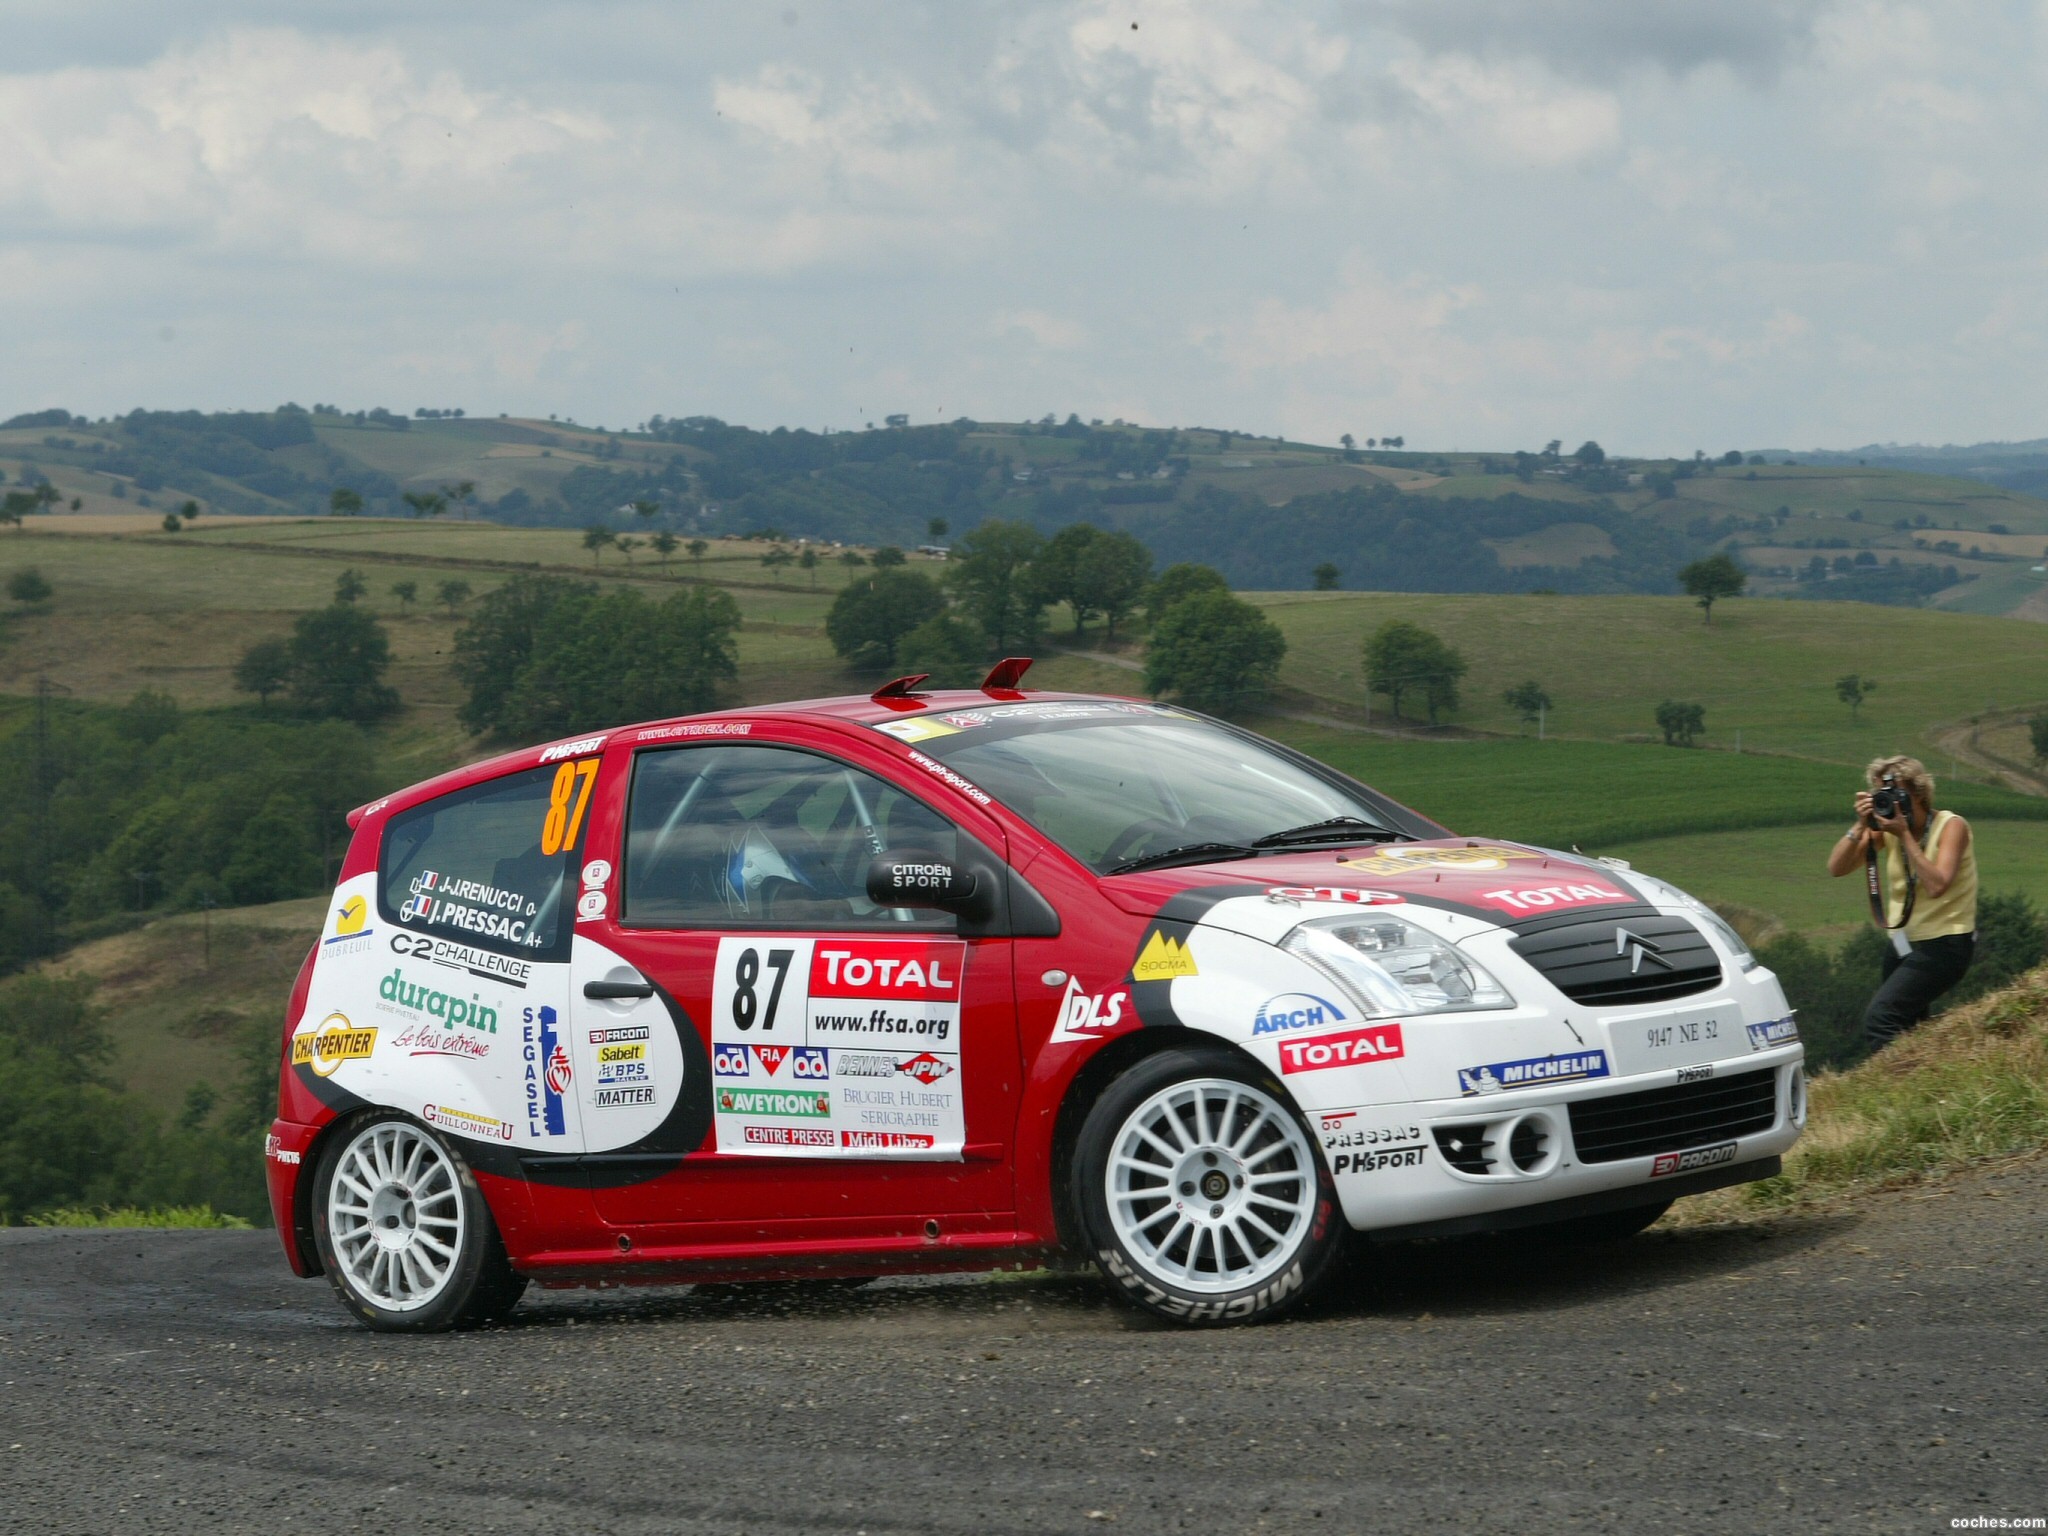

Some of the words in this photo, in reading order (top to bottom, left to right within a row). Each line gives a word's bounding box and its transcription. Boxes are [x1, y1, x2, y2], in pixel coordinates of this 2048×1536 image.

[541, 758, 600, 856] 87
[892, 863, 952, 877] CITROËN
[893, 875, 952, 888] SPORT
[1482, 884, 1625, 909] TOTAL
[428, 900, 526, 943] J.PRESSAC
[525, 931, 543, 948] A+
[321, 940, 373, 960] DUBREUIL
[390, 933, 432, 961] C2
[433, 942, 532, 980] CHALLENGE
[820, 951, 953, 988] TOTAL
[1140, 959, 1187, 972] SOCMA
[380, 968, 498, 1034] durapin
[732, 947, 796, 1031] 87
[1066, 992, 1126, 1030] DLS
[1252, 1006, 1325, 1036] ARCH
[606, 1028, 648, 1041] FACOM
[815, 1010, 950, 1039] www.ffsa.org
[1647, 1026, 1673, 1048] 9147
[1680, 1023, 1699, 1044] NE
[295, 1033, 371, 1059] CHARPENTIER
[601, 1046, 641, 1061] Sabelt
[760, 1048, 781, 1062] FIA
[1283, 1035, 1399, 1066] TOTAL
[523, 1007, 541, 1137] SEGASEL
[616, 1063, 646, 1076] BPS
[836, 1055, 899, 1077] BENNES
[904, 1061, 949, 1077] JPM
[1503, 1055, 1602, 1083] MICHELIN
[599, 1088, 653, 1105] MATTER
[734, 1092, 815, 1115] AVEYRON
[844, 1088, 895, 1106] BRUGIER
[900, 1090, 952, 1109] HUBERT
[422, 1104, 514, 1140] GUILLONNEAU
[861, 1110, 939, 1127] SERIGRAPHE
[745, 1128, 789, 1144] CENTRE
[792, 1129, 834, 1146] PRESSE
[849, 1132, 886, 1148] Midi
[887, 1134, 928, 1149] Libre
[1325, 1124, 1421, 1149] PRESSAC
[1677, 1145, 1737, 1170] FACOM
[1099, 1249, 1304, 1322] MICHELIN
